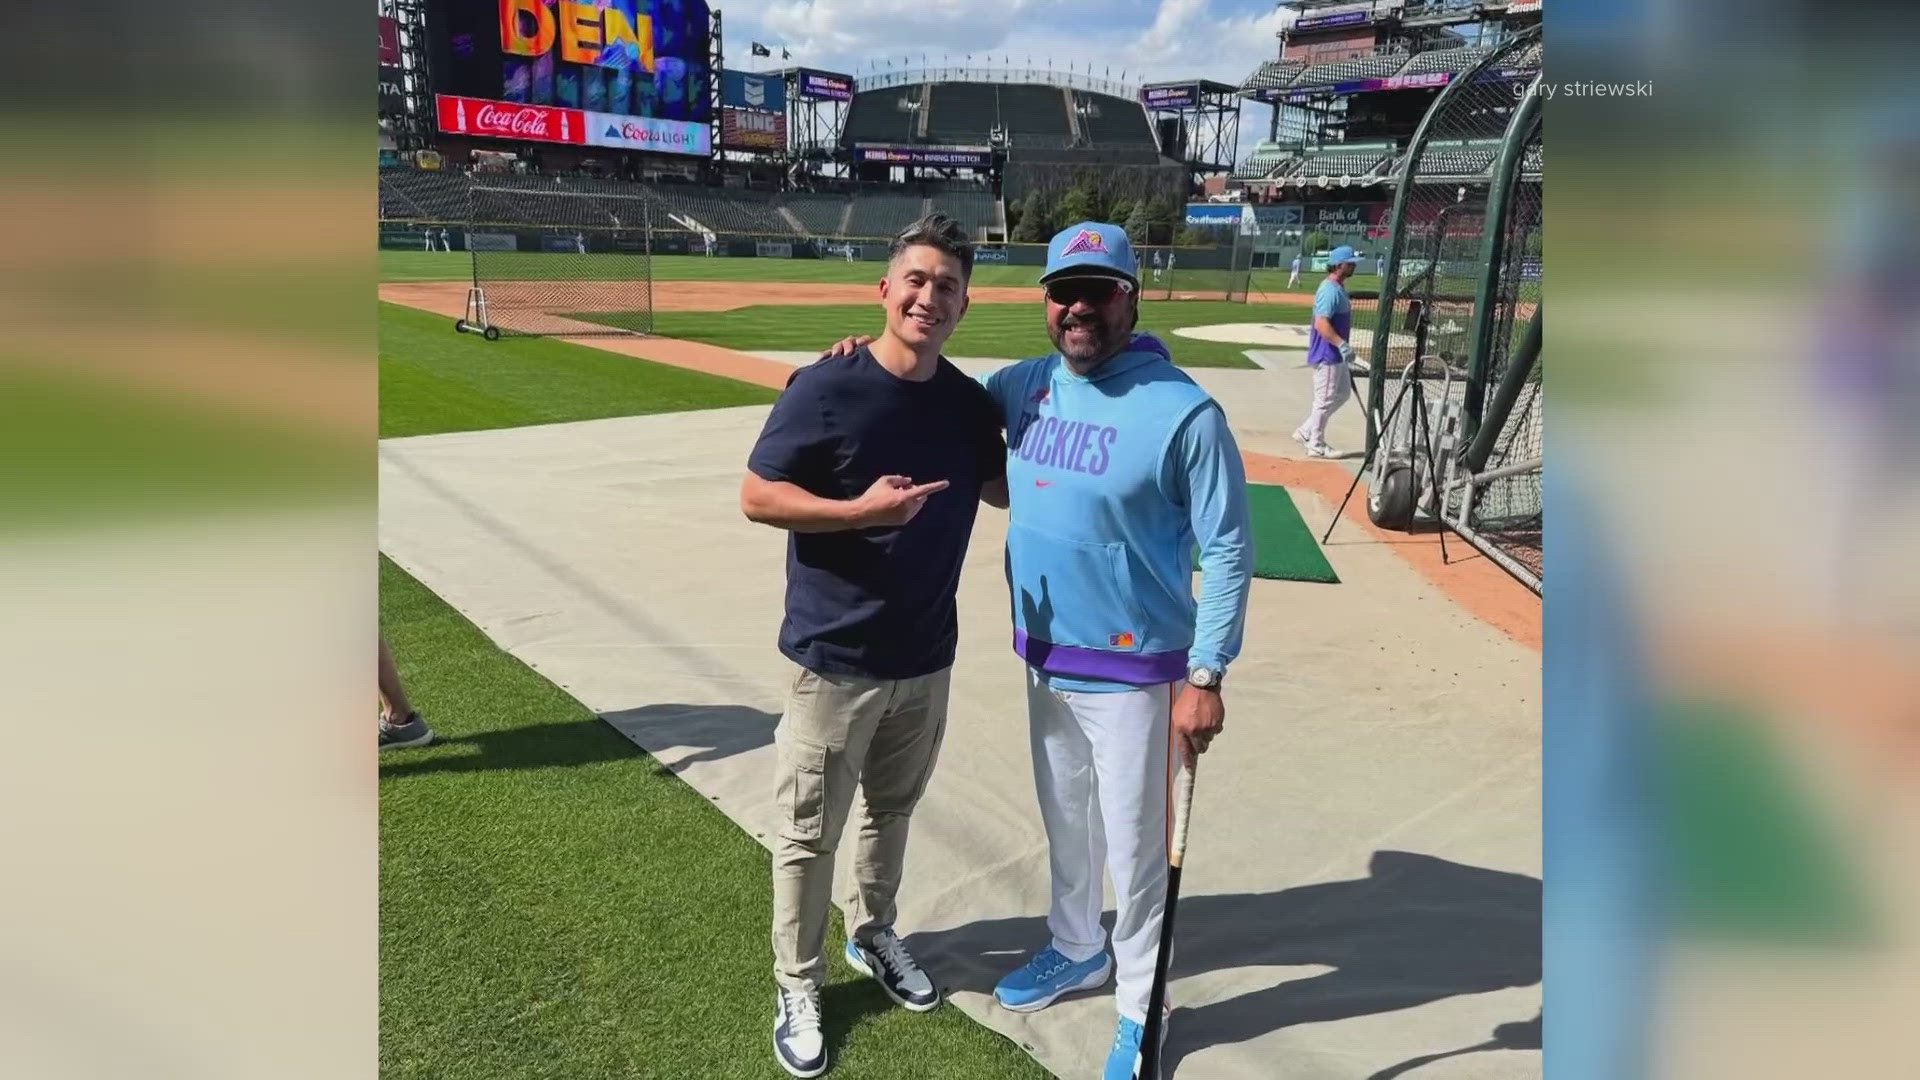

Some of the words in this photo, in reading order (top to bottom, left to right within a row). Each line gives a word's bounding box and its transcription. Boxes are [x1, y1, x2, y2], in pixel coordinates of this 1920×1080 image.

[498, 0, 655, 74] DEN
[476, 104, 548, 135] Coca-Cola
[622, 122, 660, 142] Coors
[662, 133, 697, 146] LIGHT
[865, 150, 887, 161] KING
[950, 155, 981, 163] STRETCH
[1319, 209, 1347, 221] Bank
[1349, 208, 1359, 221] of
[1318, 221, 1367, 233] Colorado
[1008, 411, 1118, 476] ROCKIES
